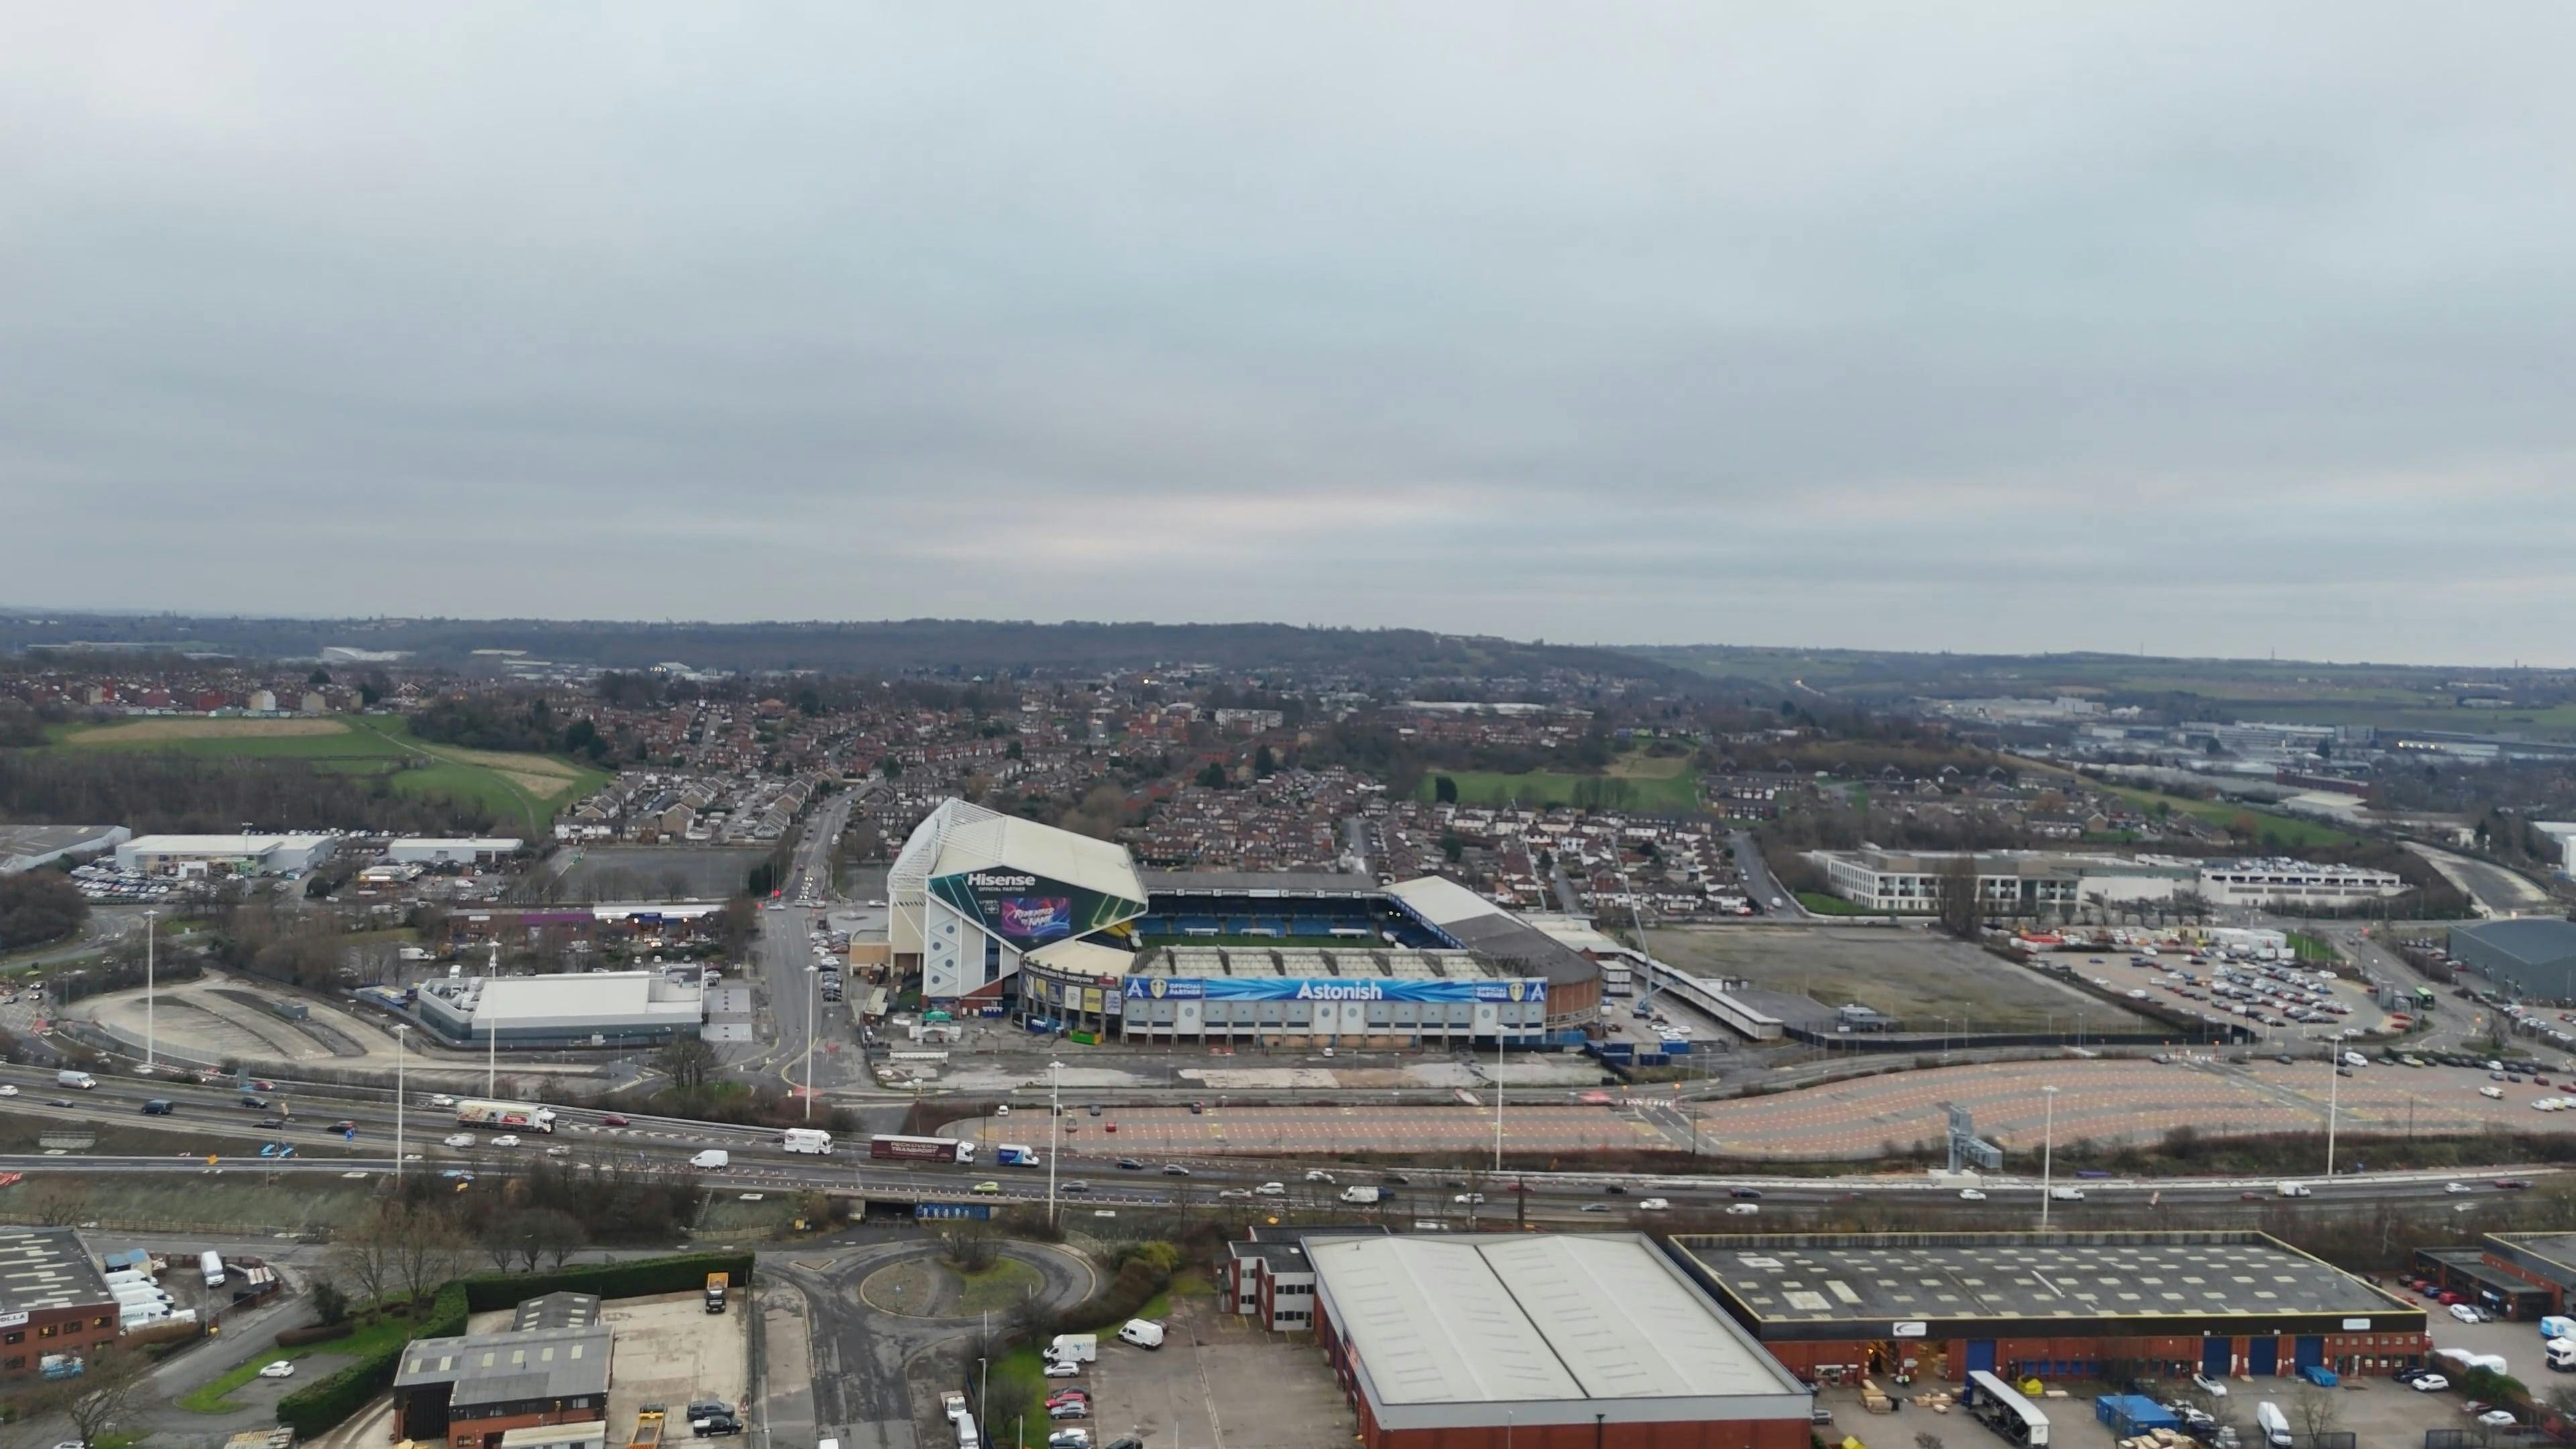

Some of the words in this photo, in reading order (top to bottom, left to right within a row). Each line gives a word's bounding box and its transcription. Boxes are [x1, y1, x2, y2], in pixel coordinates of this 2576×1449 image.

[968, 873, 1036, 886] Hisense
[1066, 975, 1095, 984] everyone
[1296, 980, 1383, 1000] Astonish
